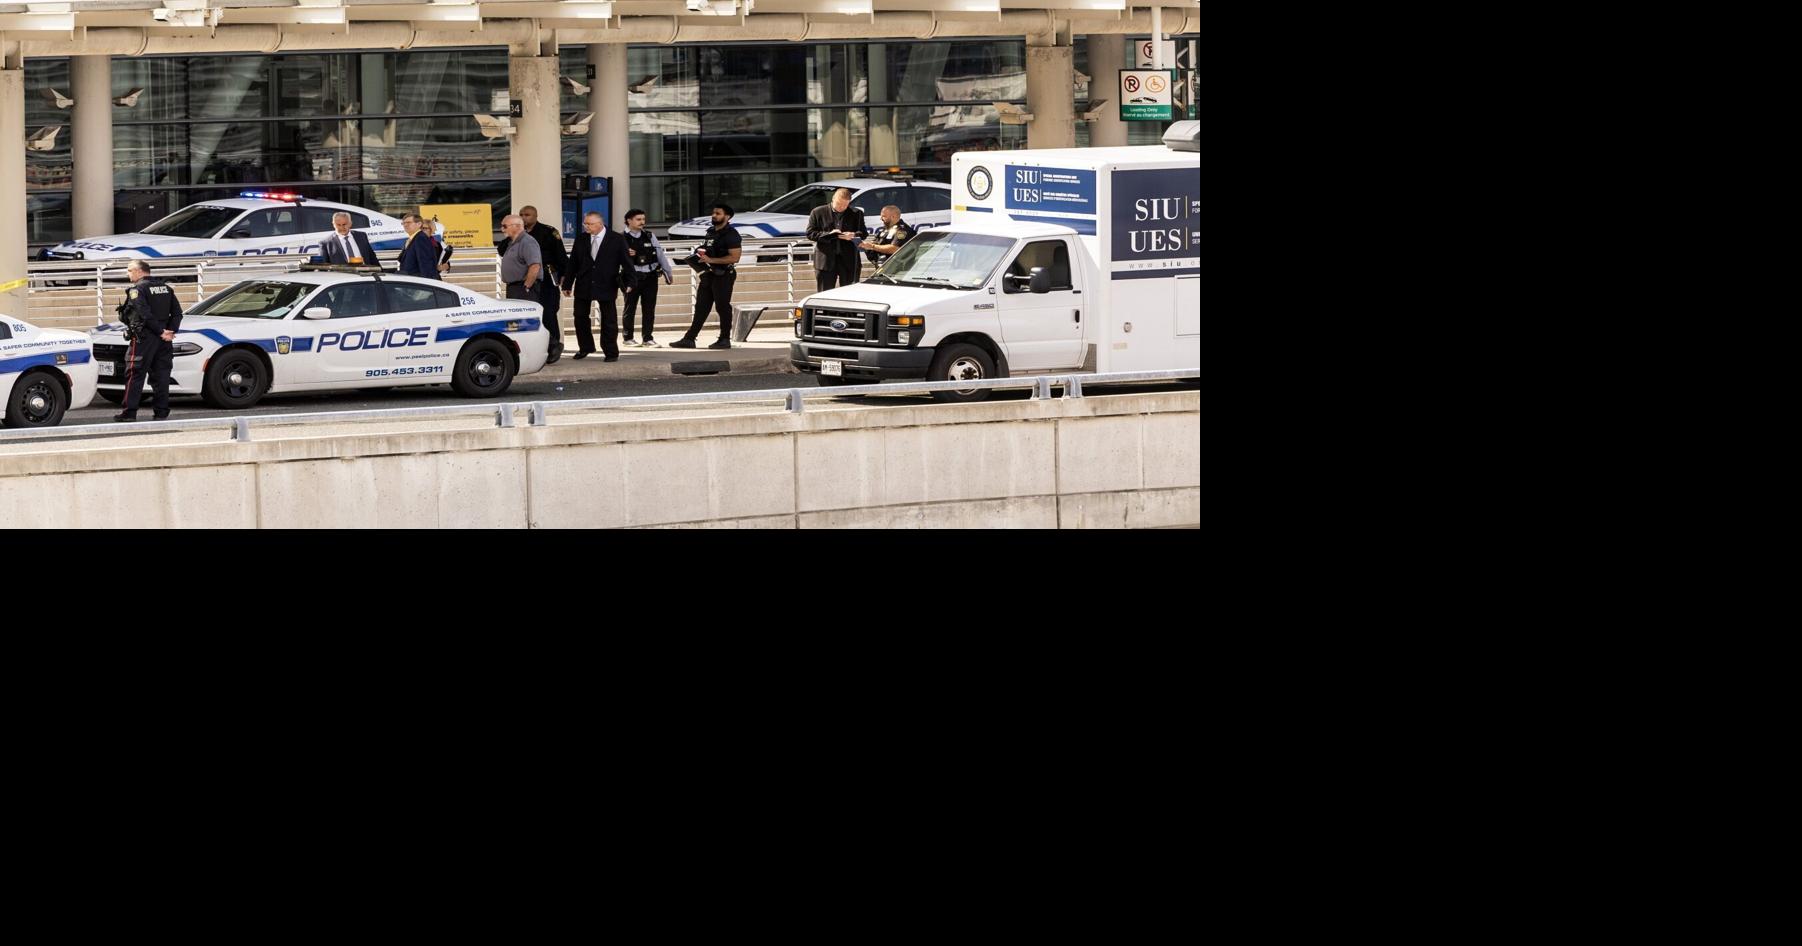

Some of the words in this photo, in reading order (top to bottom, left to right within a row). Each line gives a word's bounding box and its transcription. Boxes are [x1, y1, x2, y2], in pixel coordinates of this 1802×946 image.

[1016, 170, 1038, 184] SIU
[1013, 188, 1039, 203] UES
[1135, 198, 1181, 221] SIU
[371, 219, 383, 227] 945
[1128, 229, 1182, 253] UES
[149, 286, 169, 295] POLICE
[461, 297, 476, 305] 256
[316, 326, 431, 353] POLICE
[365, 365, 444, 377] 905.453.3311
